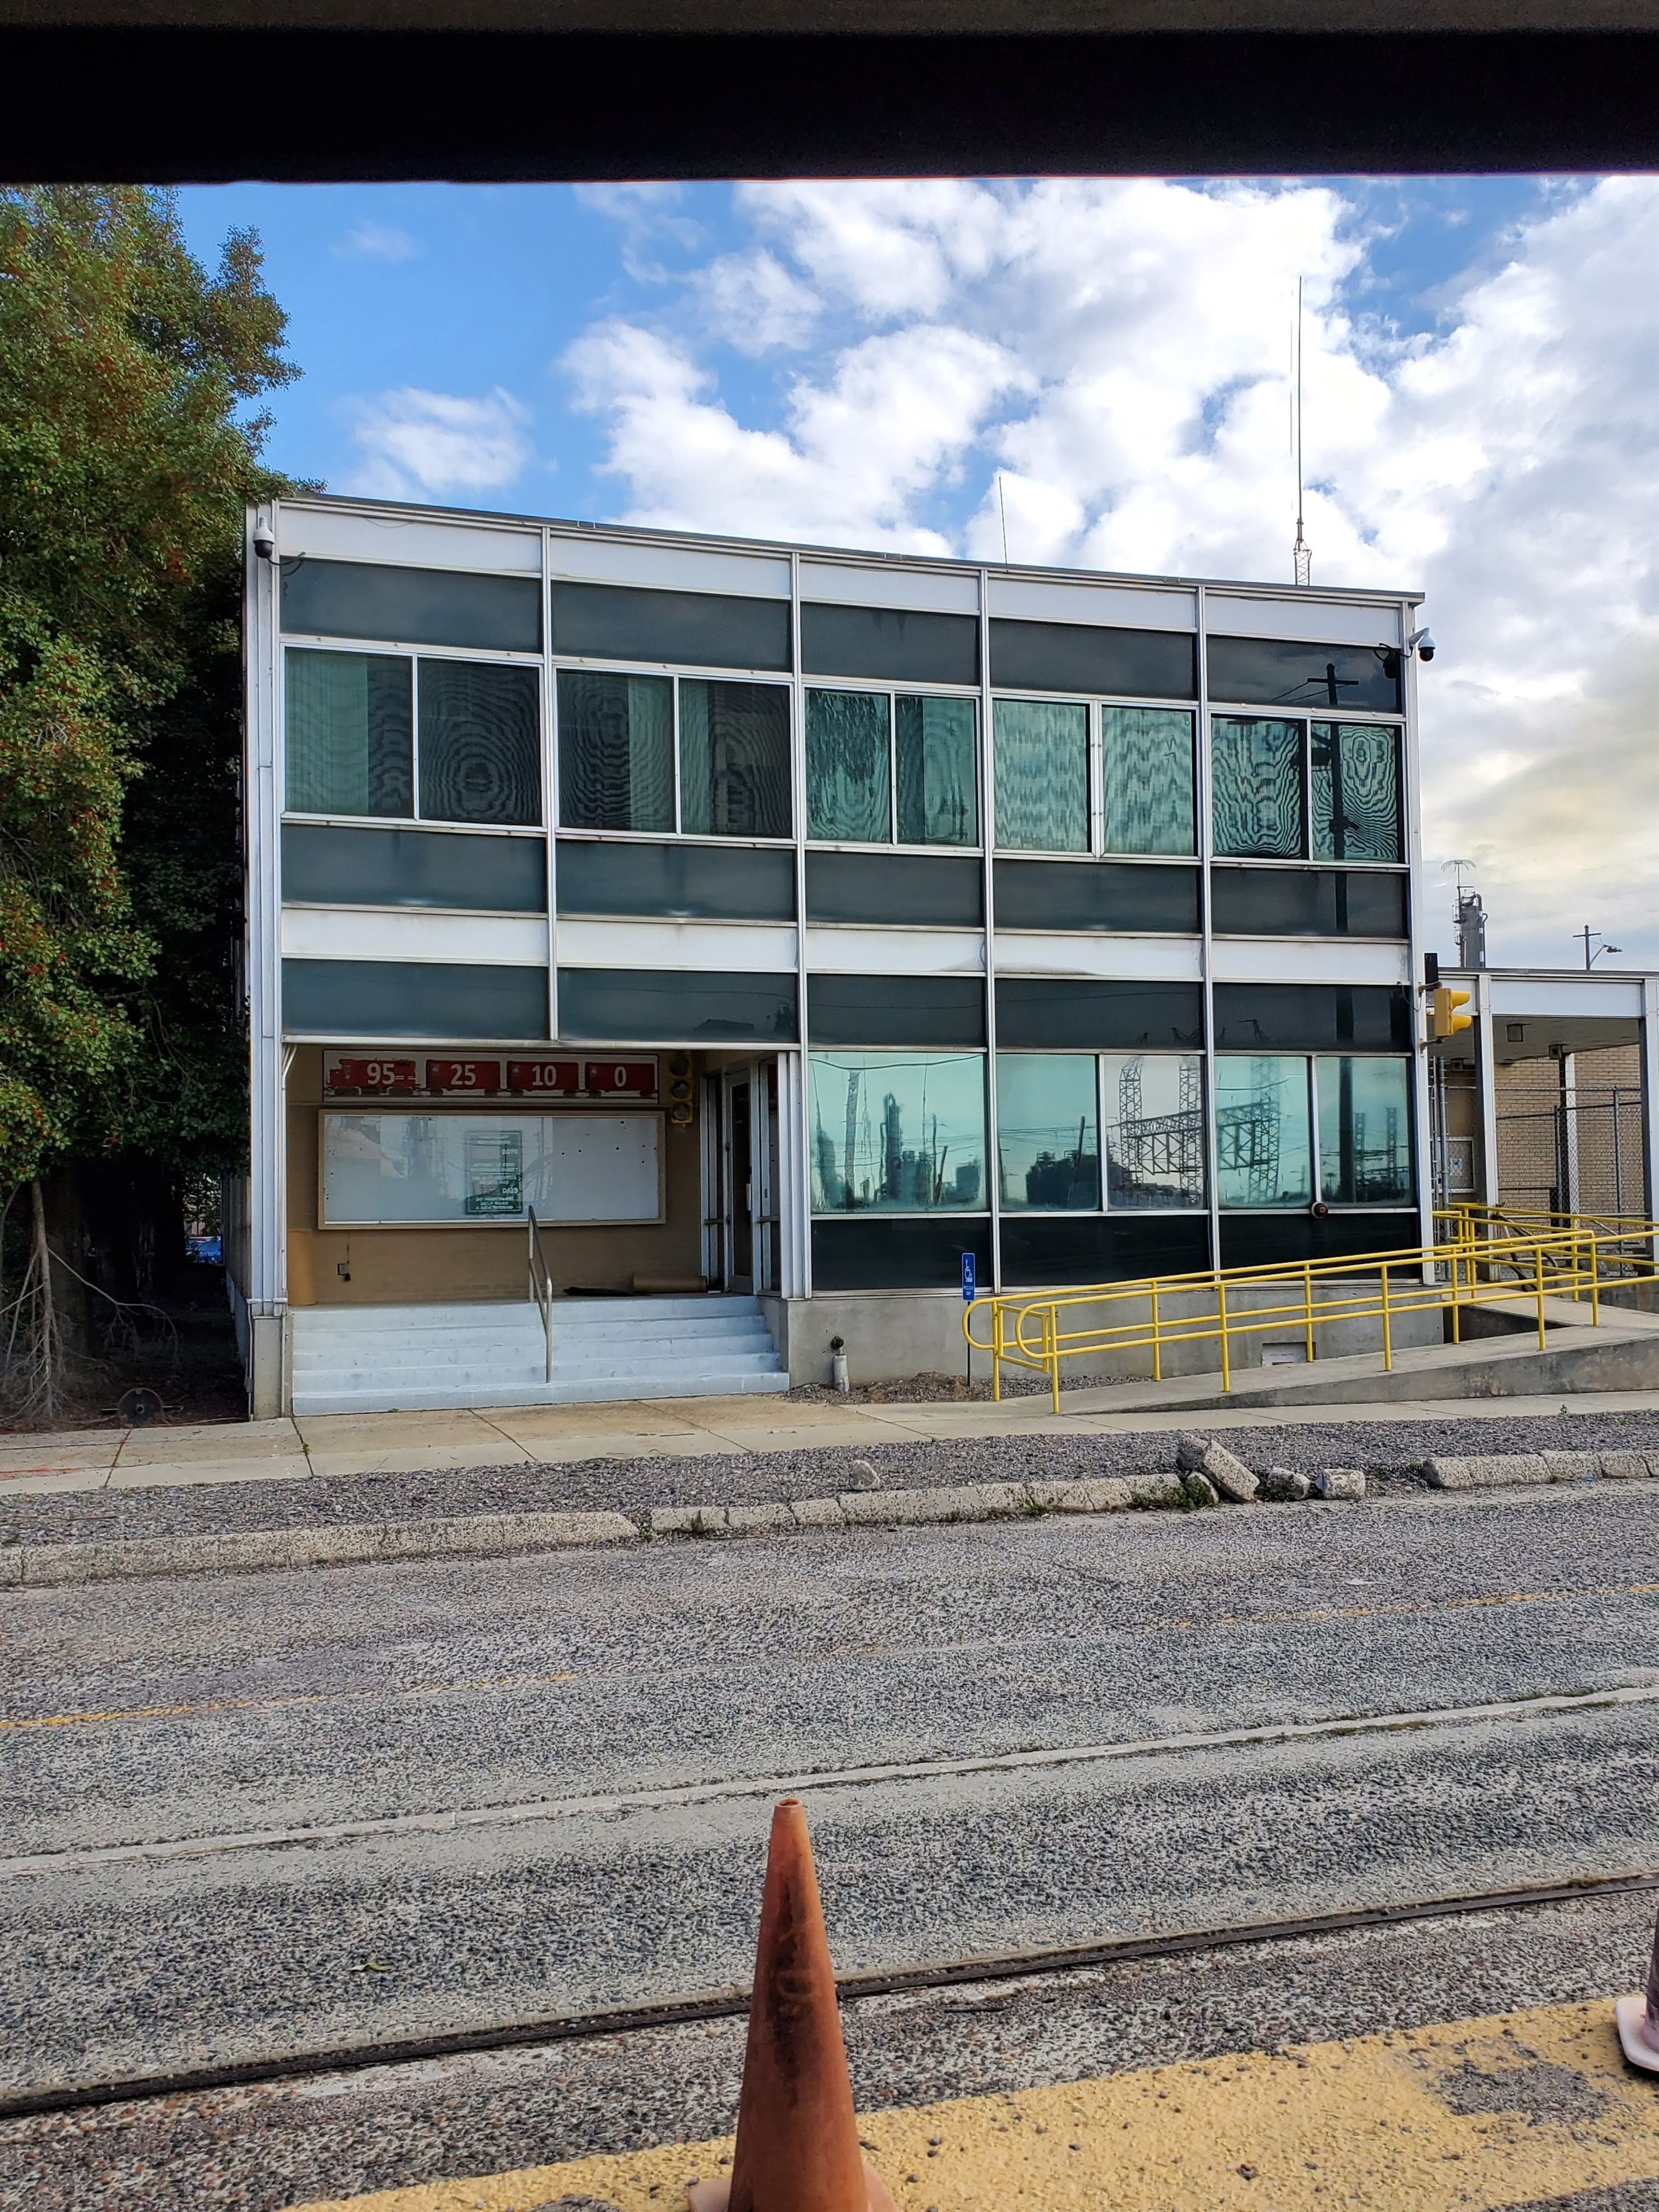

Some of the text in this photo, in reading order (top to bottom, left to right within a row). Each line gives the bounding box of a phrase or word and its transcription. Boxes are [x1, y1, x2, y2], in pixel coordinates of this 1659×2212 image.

[366, 1063, 627, 1087] 95 25 10 0
